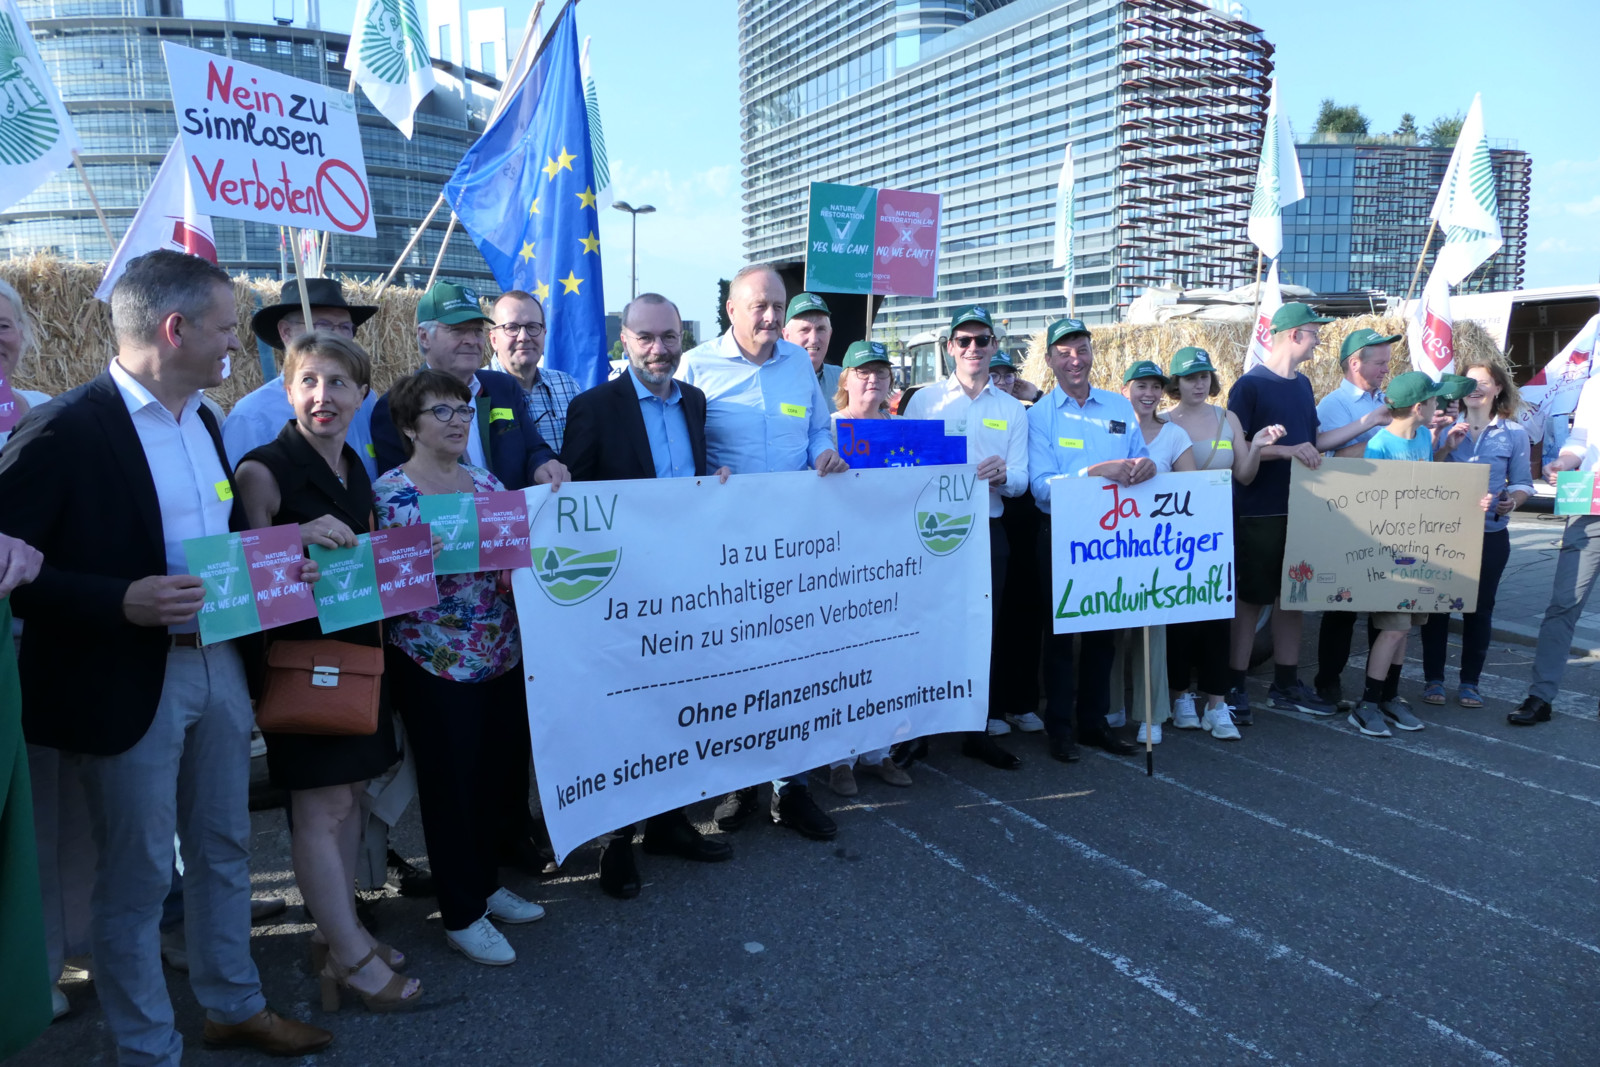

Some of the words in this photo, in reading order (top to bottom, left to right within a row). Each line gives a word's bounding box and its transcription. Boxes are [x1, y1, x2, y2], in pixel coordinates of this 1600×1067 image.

[207, 60, 284, 116] Nein
[288, 94, 328, 126] zu
[192, 155, 319, 216] Verboten
[820, 210, 864, 219] RESTORATION
[880, 216, 922, 225] RESTORATION
[831, 243, 845, 253] WE
[847, 244, 869, 255] CAN!
[892, 247, 904, 258] WE
[840, 423, 870, 456] Ja
[938, 474, 976, 503] RLV
[1099, 484, 1140, 530] Ja
[1150, 490, 1194, 518] zu
[1326, 495, 1348, 512] no
[1356, 489, 1388, 510] crop
[1395, 486, 1460, 509] protection
[558, 495, 618, 533] RLV
[1370, 519, 1415, 536] Worse
[392, 547, 415, 555] NATURE
[494, 539, 503, 547] WE
[719, 544, 739, 566] Ja
[745, 544, 766, 562] zu
[775, 531, 841, 560] Europa!
[1071, 522, 1223, 571] nachhaltiger
[265, 551, 287, 559] NATURE
[378, 552, 418, 564] RESTORATION
[1346, 545, 1374, 564] more
[1378, 540, 1429, 563] importing
[1435, 544, 1466, 560] from
[208, 561, 230, 570] NATURE
[252, 557, 290, 569] RESTORATION
[330, 560, 355, 568] NATURE
[1367, 567, 1386, 582] the
[1391, 565, 1453, 580] rainforest
[271, 587, 282, 597] WE
[395, 579, 406, 588] WE
[604, 597, 628, 621] Ja
[637, 596, 663, 617] zu
[671, 578, 793, 613] nachhaltiger
[799, 556, 922, 593] Landwirtschaft!
[218, 598, 231, 609] WE
[337, 591, 350, 602] WE
[641, 631, 694, 657] Nein
[701, 629, 723, 648] zu
[731, 613, 815, 643] sinnlosen
[820, 593, 898, 625] Verboten!
[677, 701, 737, 728] Ohne
[744, 669, 873, 715] Pflanzenschutz
[556, 771, 607, 811] keine
[613, 748, 689, 785] sichere
[695, 718, 810, 760] Versorgung
[814, 707, 842, 732] mit
[847, 679, 973, 722] Lebensmitteln!
